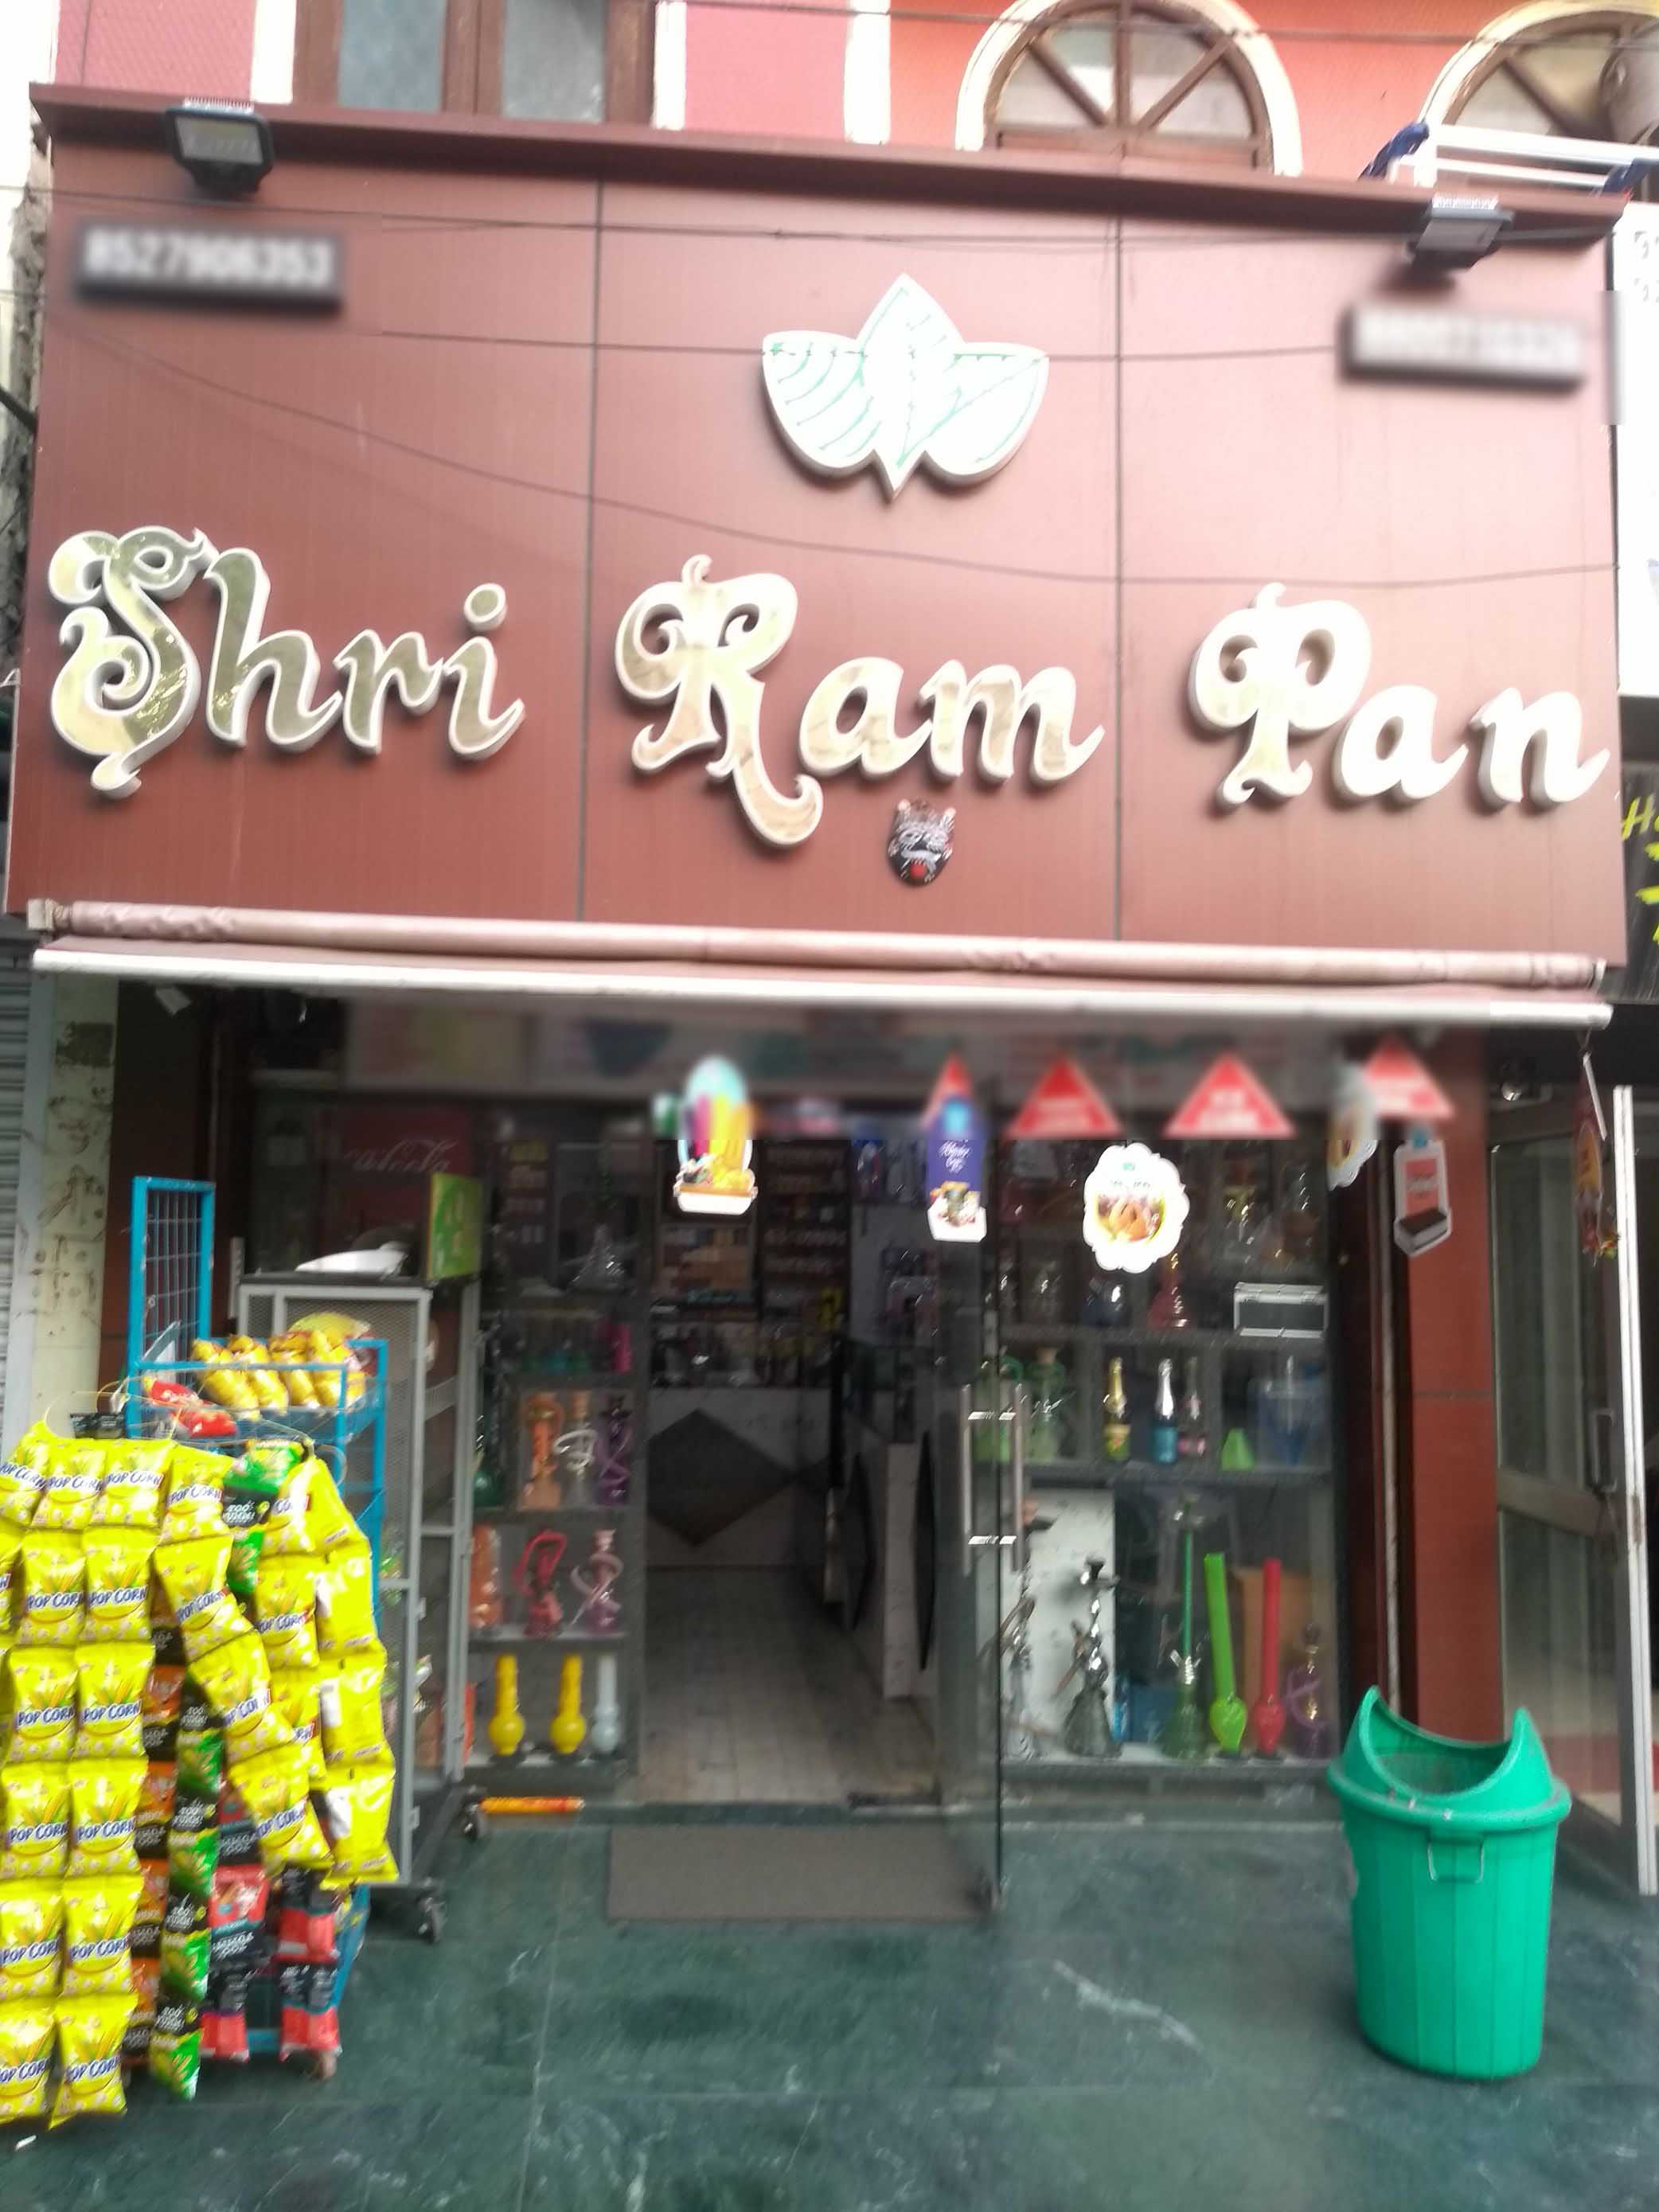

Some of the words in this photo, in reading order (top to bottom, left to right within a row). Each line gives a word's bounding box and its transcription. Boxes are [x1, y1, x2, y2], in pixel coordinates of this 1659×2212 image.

[49, 526, 525, 798] Shri
[615, 554, 1105, 849] Ram
[1182, 582, 1610, 805] Pan
[28, 1595, 51, 1609] POP
[89, 1592, 111, 1606] POP
[114, 1587, 147, 1603] CORN
[18, 1711, 41, 1726] POP
[83, 1708, 104, 1722] POP
[107, 1702, 140, 1718] CORN
[10, 1828, 33, 1843] POP
[35, 1823, 68, 1840] CORN
[76, 1825, 100, 1839] POP
[2, 1947, 27, 1963] POP
[70, 1945, 96, 1960] POP
